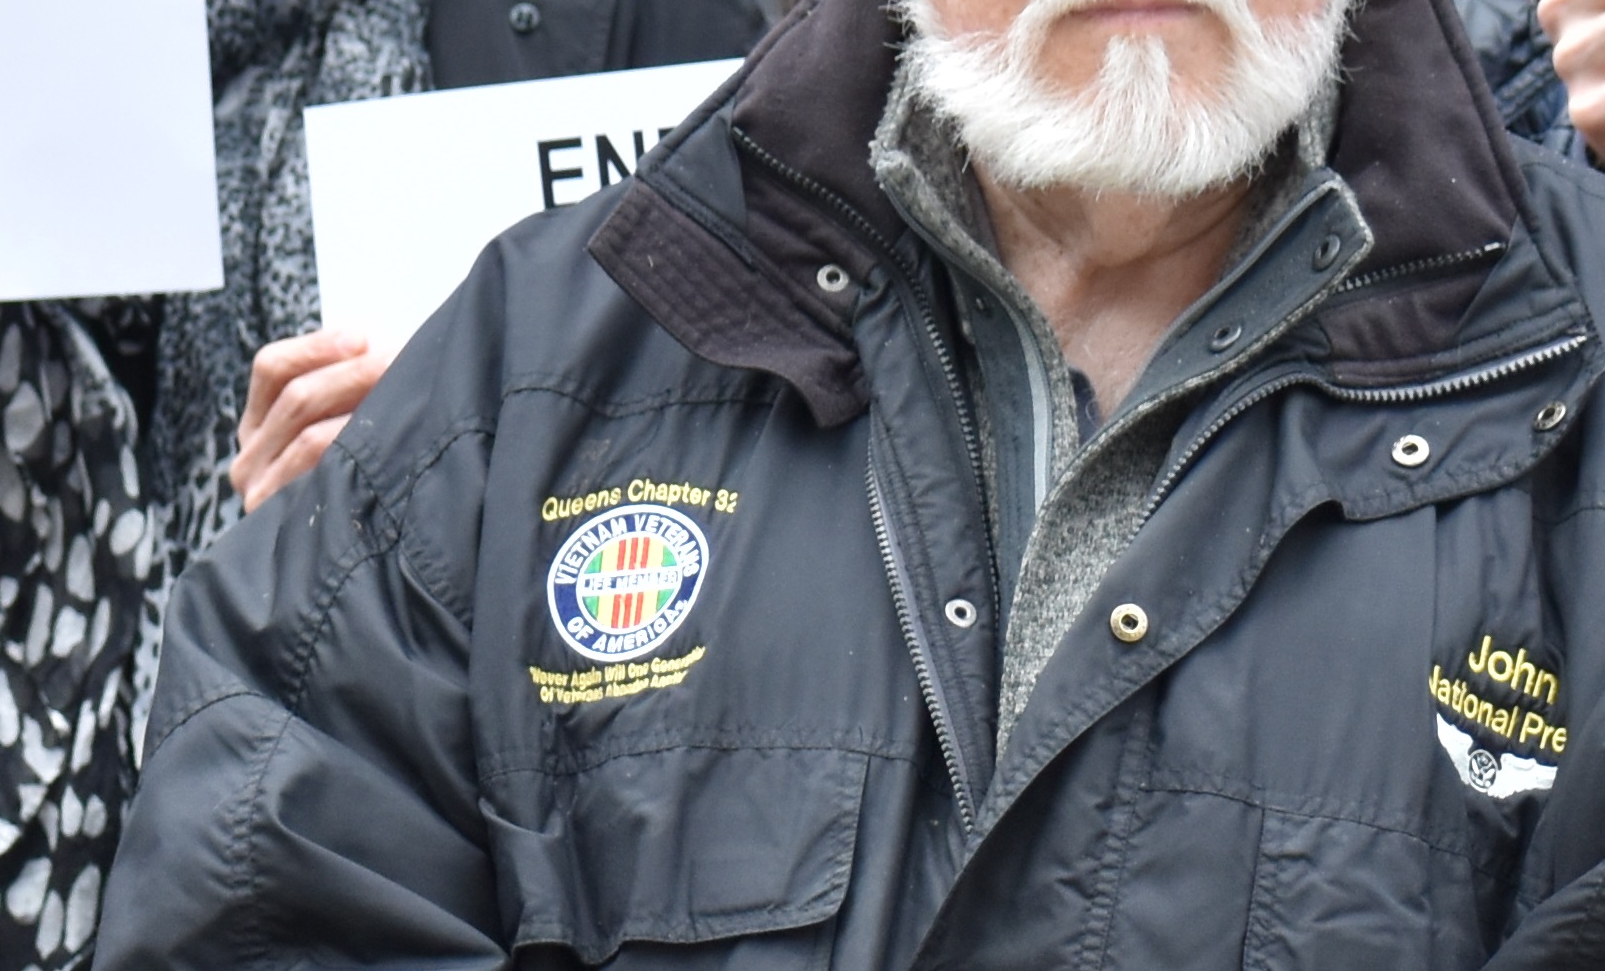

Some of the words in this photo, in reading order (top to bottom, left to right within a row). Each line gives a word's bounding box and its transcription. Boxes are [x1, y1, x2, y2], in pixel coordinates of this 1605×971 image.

[536, 125, 682, 210] EN
[541, 486, 622, 522] Queens
[627, 478, 711, 507] Chapter
[554, 516, 628, 584] VIETNAM
[633, 514, 700, 577] VETERANS
[566, 616, 595, 641] OF
[1468, 634, 1559, 705] John
